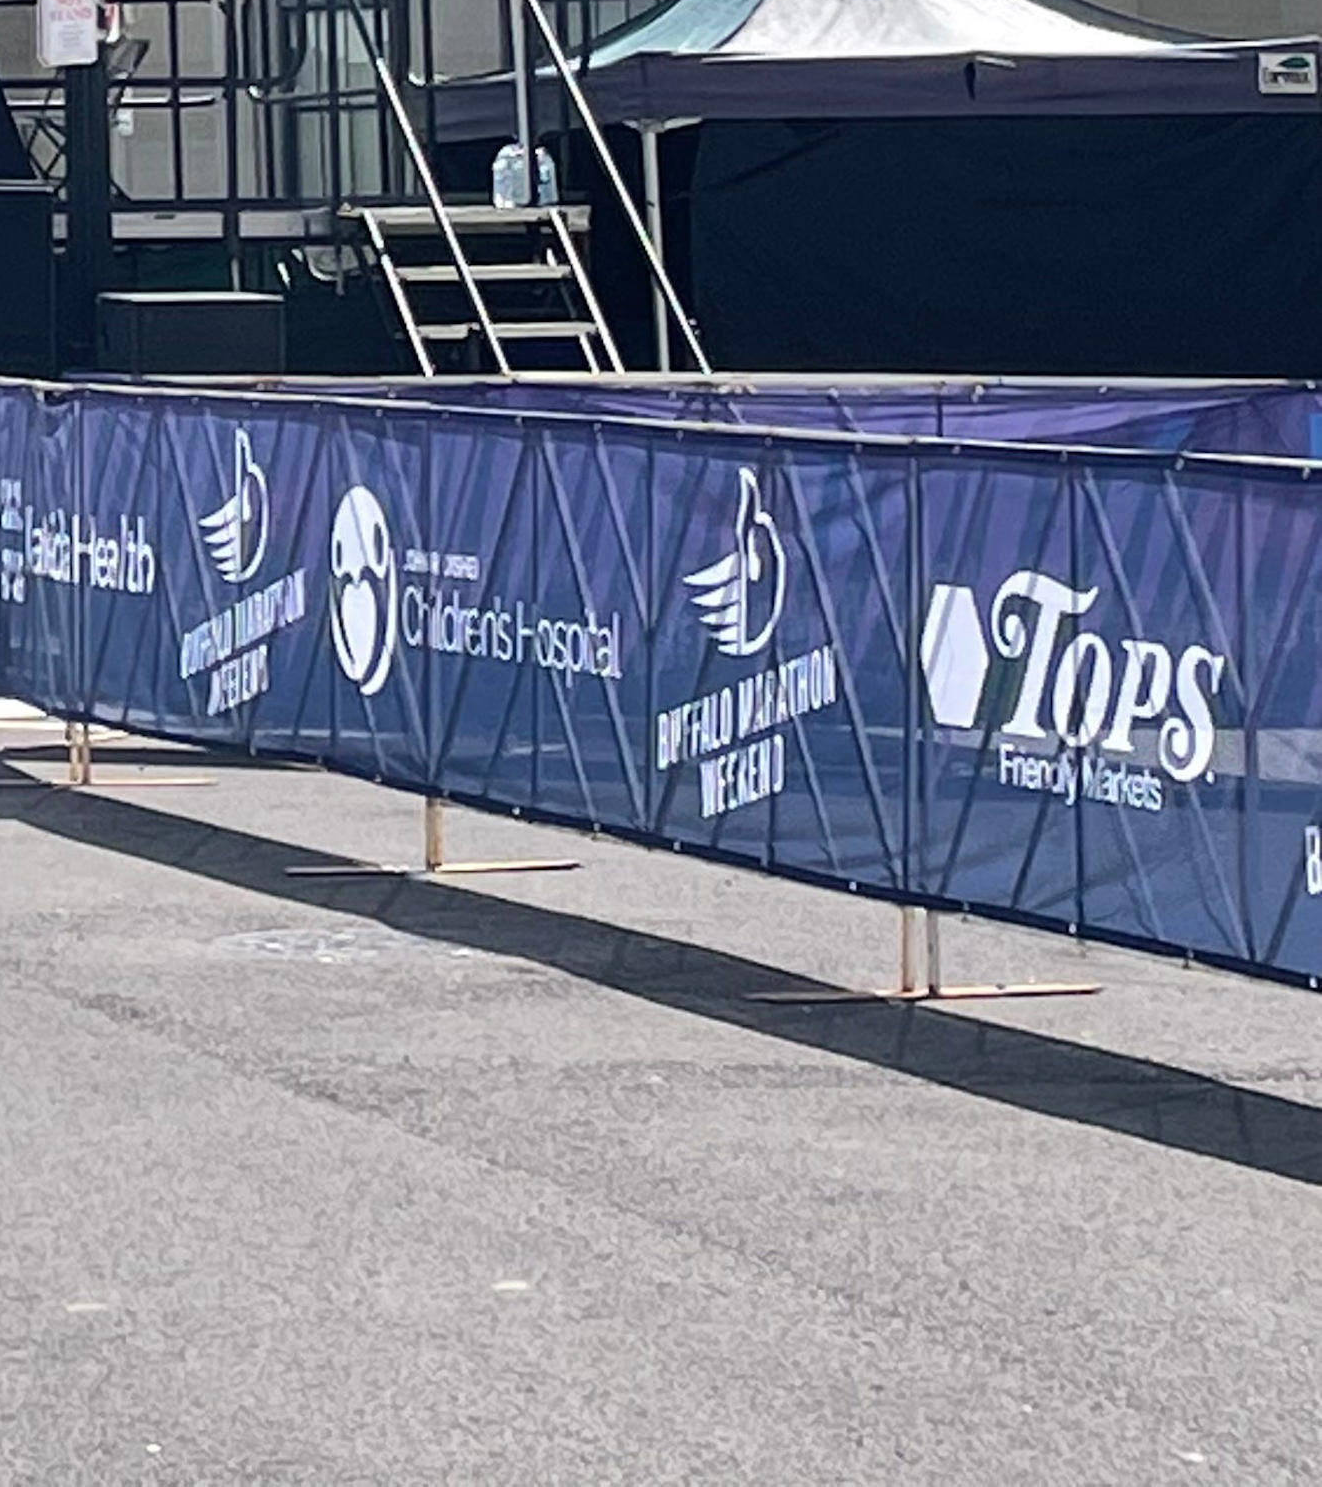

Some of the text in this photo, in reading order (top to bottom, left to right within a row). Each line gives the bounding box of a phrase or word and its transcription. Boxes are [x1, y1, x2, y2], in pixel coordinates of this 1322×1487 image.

[71, 512, 155, 595] Health
[402, 584, 513, 661] Children's
[657, 687, 733, 771] BUFFALO
[699, 733, 785, 818] WEEKEND
[999, 743, 1163, 811] Friendly Markets
